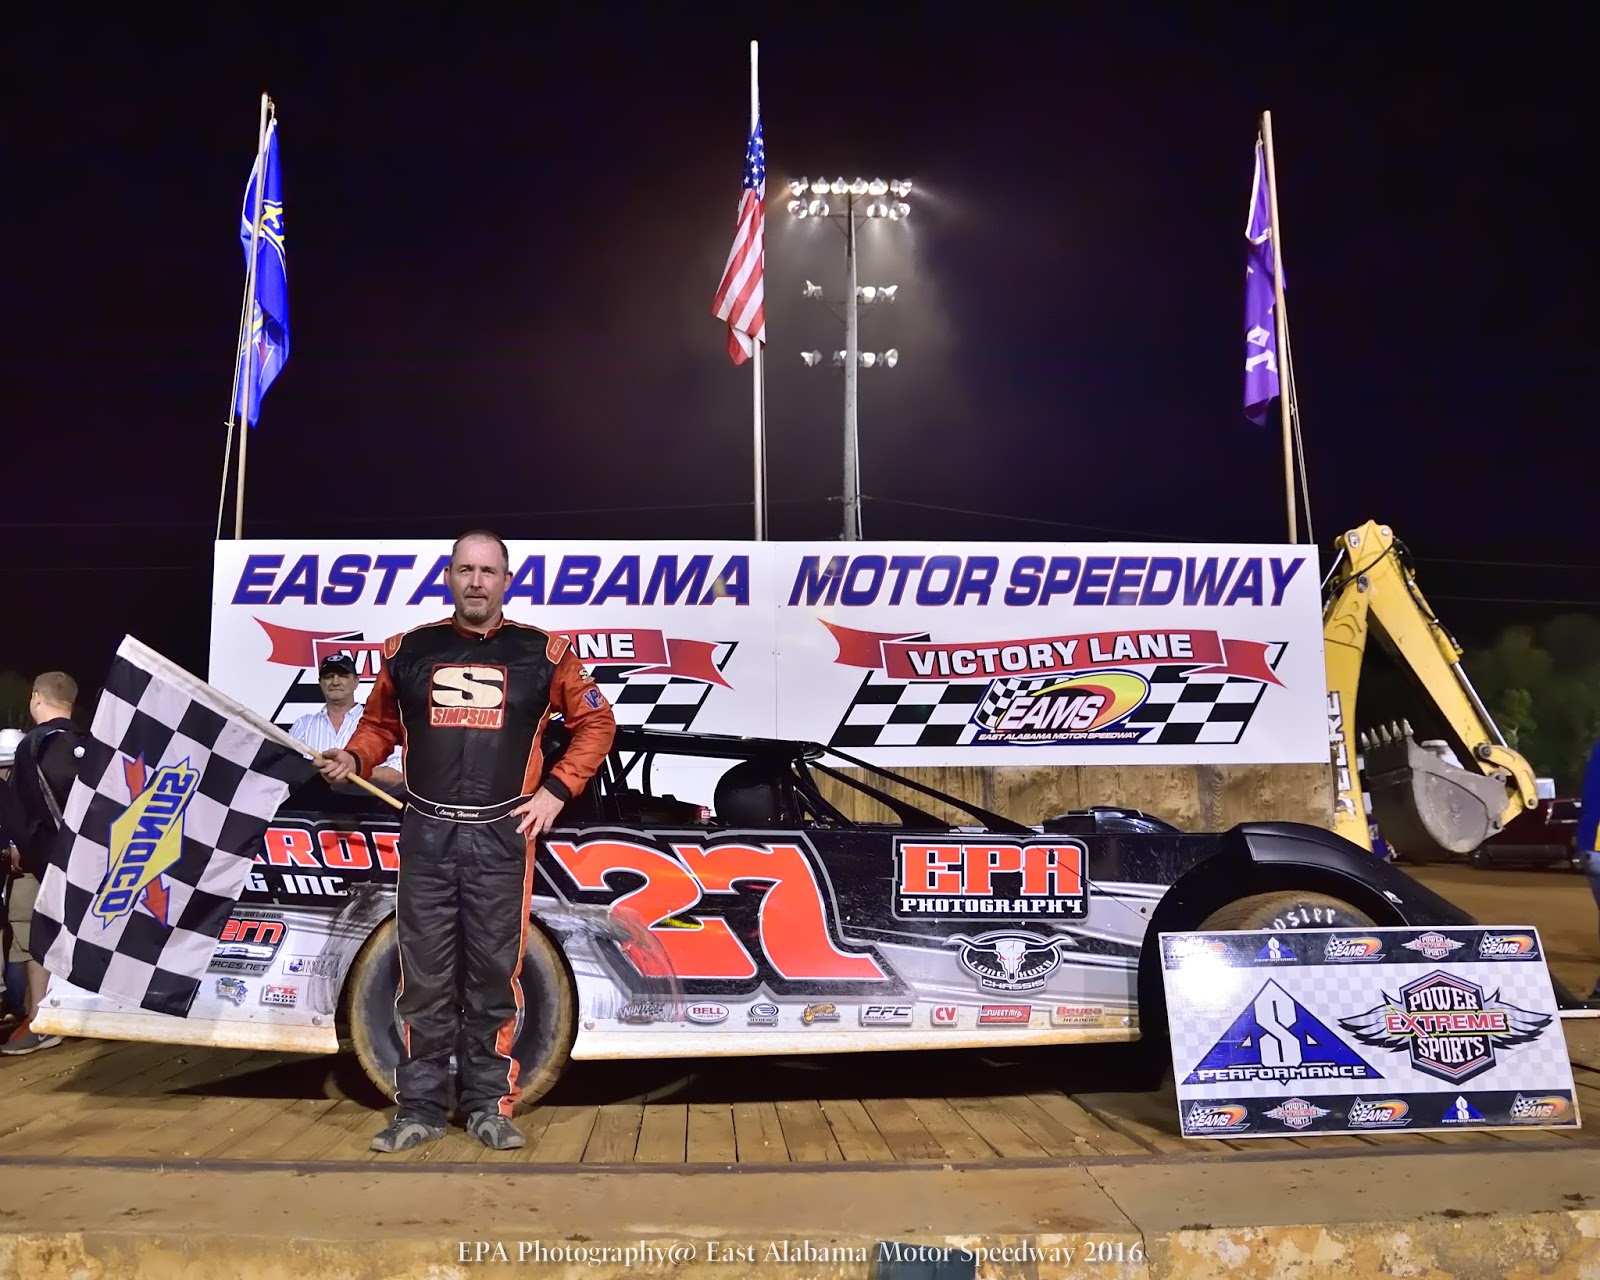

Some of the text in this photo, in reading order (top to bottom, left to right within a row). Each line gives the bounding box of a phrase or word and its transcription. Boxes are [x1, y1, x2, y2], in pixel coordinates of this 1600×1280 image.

[230, 554, 1306, 607] EAST AABAMA MOTOR SPEEDWAY
[560, 633, 635, 658] NE
[907, 632, 1194, 677] VICTORY LANE
[997, 696, 1106, 730] EAMS
[978, 731, 1140, 741] EAST ALABAMA MOTOR SPEEDWAY
[900, 843, 1084, 896] EPA
[546, 840, 890, 981] 27
[900, 898, 1083, 914] PHOTOGRAPHY
[219, 919, 284, 944] ern
[1335, 946, 1367, 956] EAMS
[1488, 943, 1519, 953] EAMS
[982, 978, 1045, 990] CHASSIS
[1408, 986, 1480, 1011] POWER
[692, 1007, 724, 1015] BELL
[865, 1006, 912, 1016] PFC
[935, 1007, 957, 1021] CV
[1386, 1009, 1508, 1038] EXTREME
[1417, 1036, 1485, 1063] SPORTS
[1200, 1065, 1367, 1081] PERFORMANCE
[1358, 1109, 1392, 1121] EAMS
[1520, 1106, 1552, 1117] EAMS
[1196, 1114, 1231, 1126] EAMS
